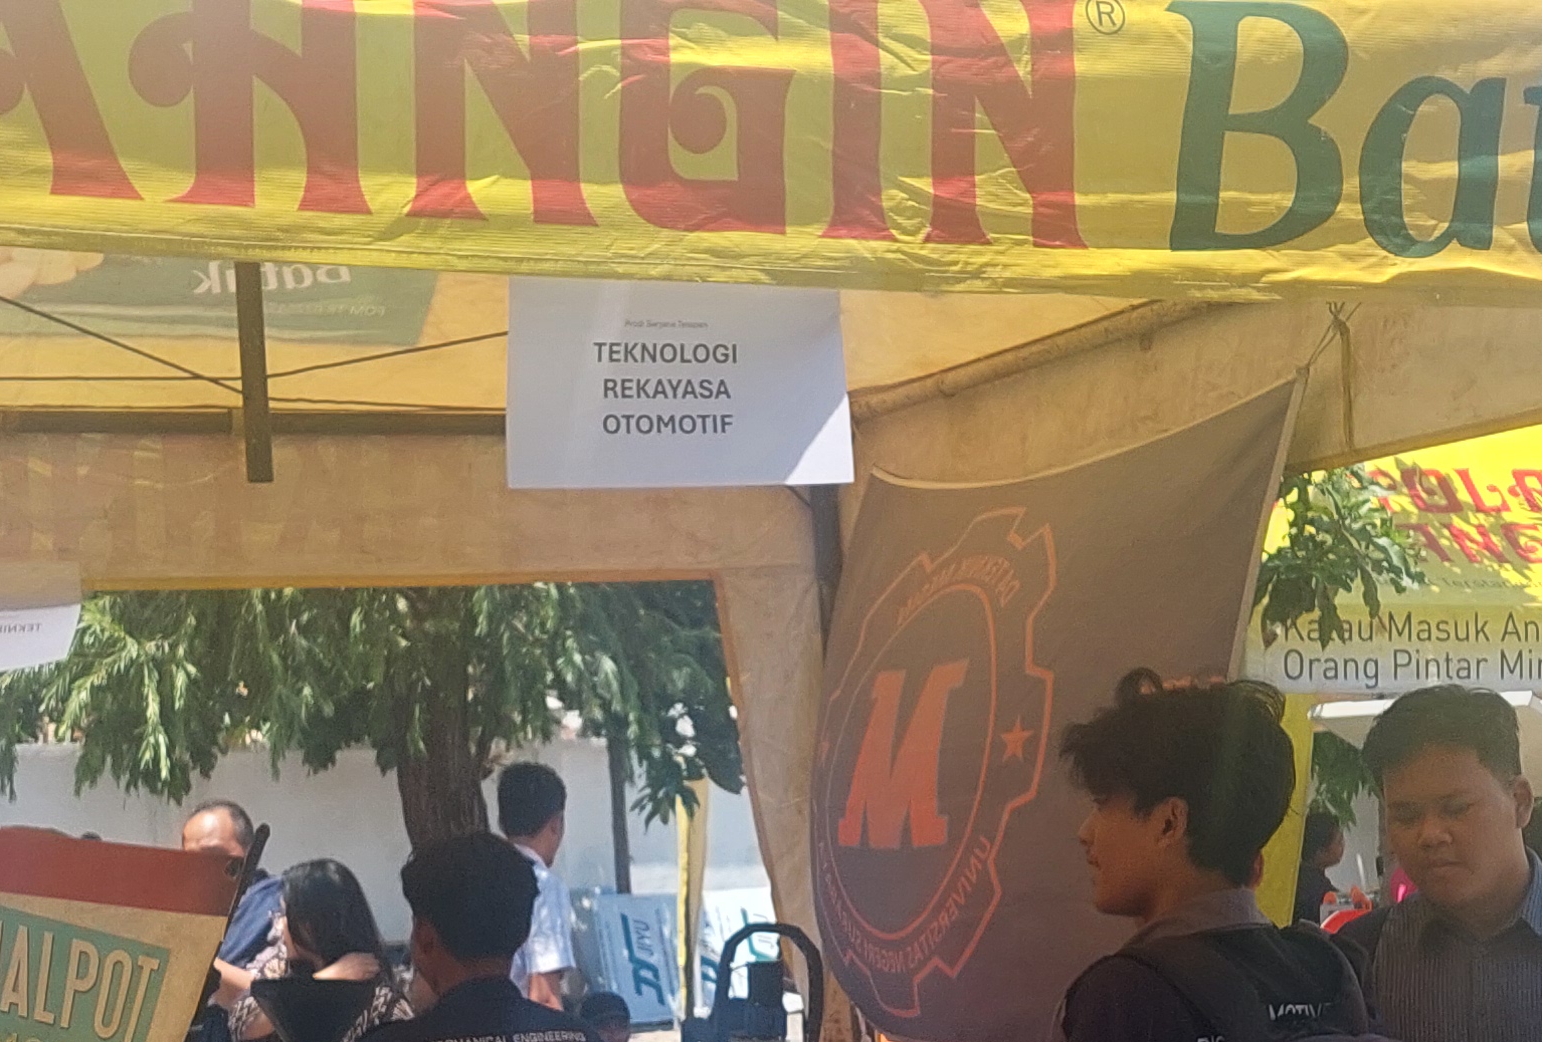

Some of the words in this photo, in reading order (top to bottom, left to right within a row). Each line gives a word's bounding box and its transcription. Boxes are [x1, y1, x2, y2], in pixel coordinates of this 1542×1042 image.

[593, 342, 738, 364] TEKNOLOGI
[603, 378, 732, 400] REKAYASA
[602, 414, 734, 435] OTOMOTIF
[1282, 614, 1375, 644] Kaau
[1386, 611, 1491, 644] Masuk
[1282, 648, 1380, 689] Orang
[1392, 649, 1489, 681] Pintar
